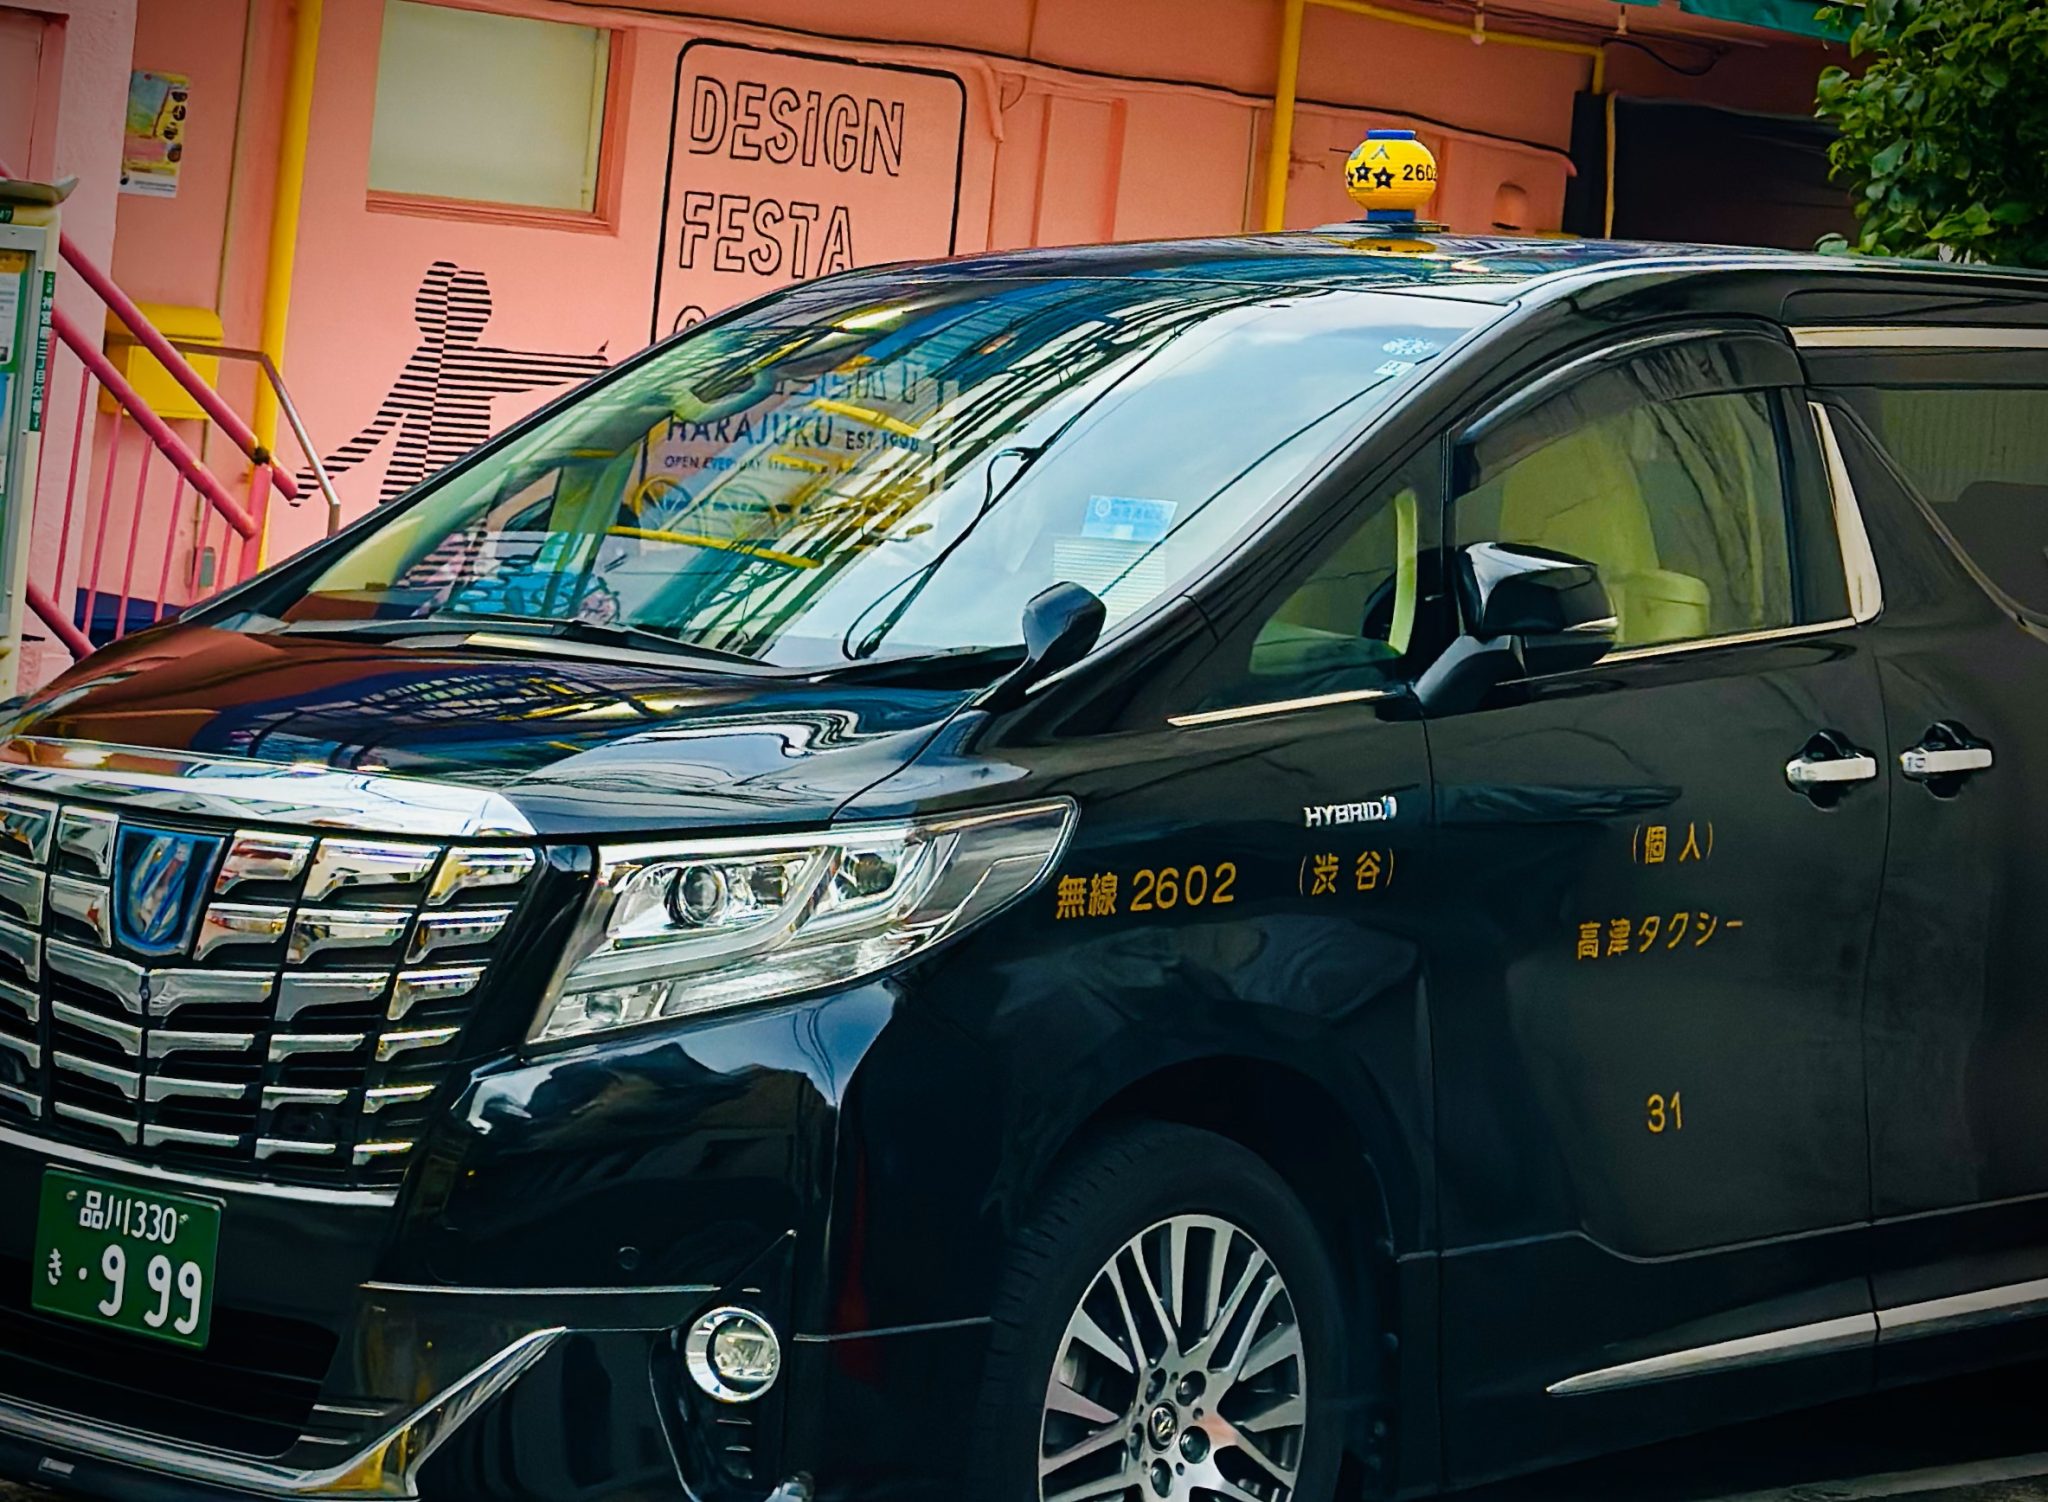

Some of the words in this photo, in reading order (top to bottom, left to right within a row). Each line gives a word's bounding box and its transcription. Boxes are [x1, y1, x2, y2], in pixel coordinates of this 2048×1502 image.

[689, 75, 905, 177] DESIGN
[679, 190, 854, 279] FESTA
[666, 411, 834, 447] HARAJUKU
[1303, 801, 1383, 828] HYBRID
[1056, 871, 1118, 919] 無線
[1130, 862, 1237, 912] 2602
[1647, 1091, 1682, 1133] 31
